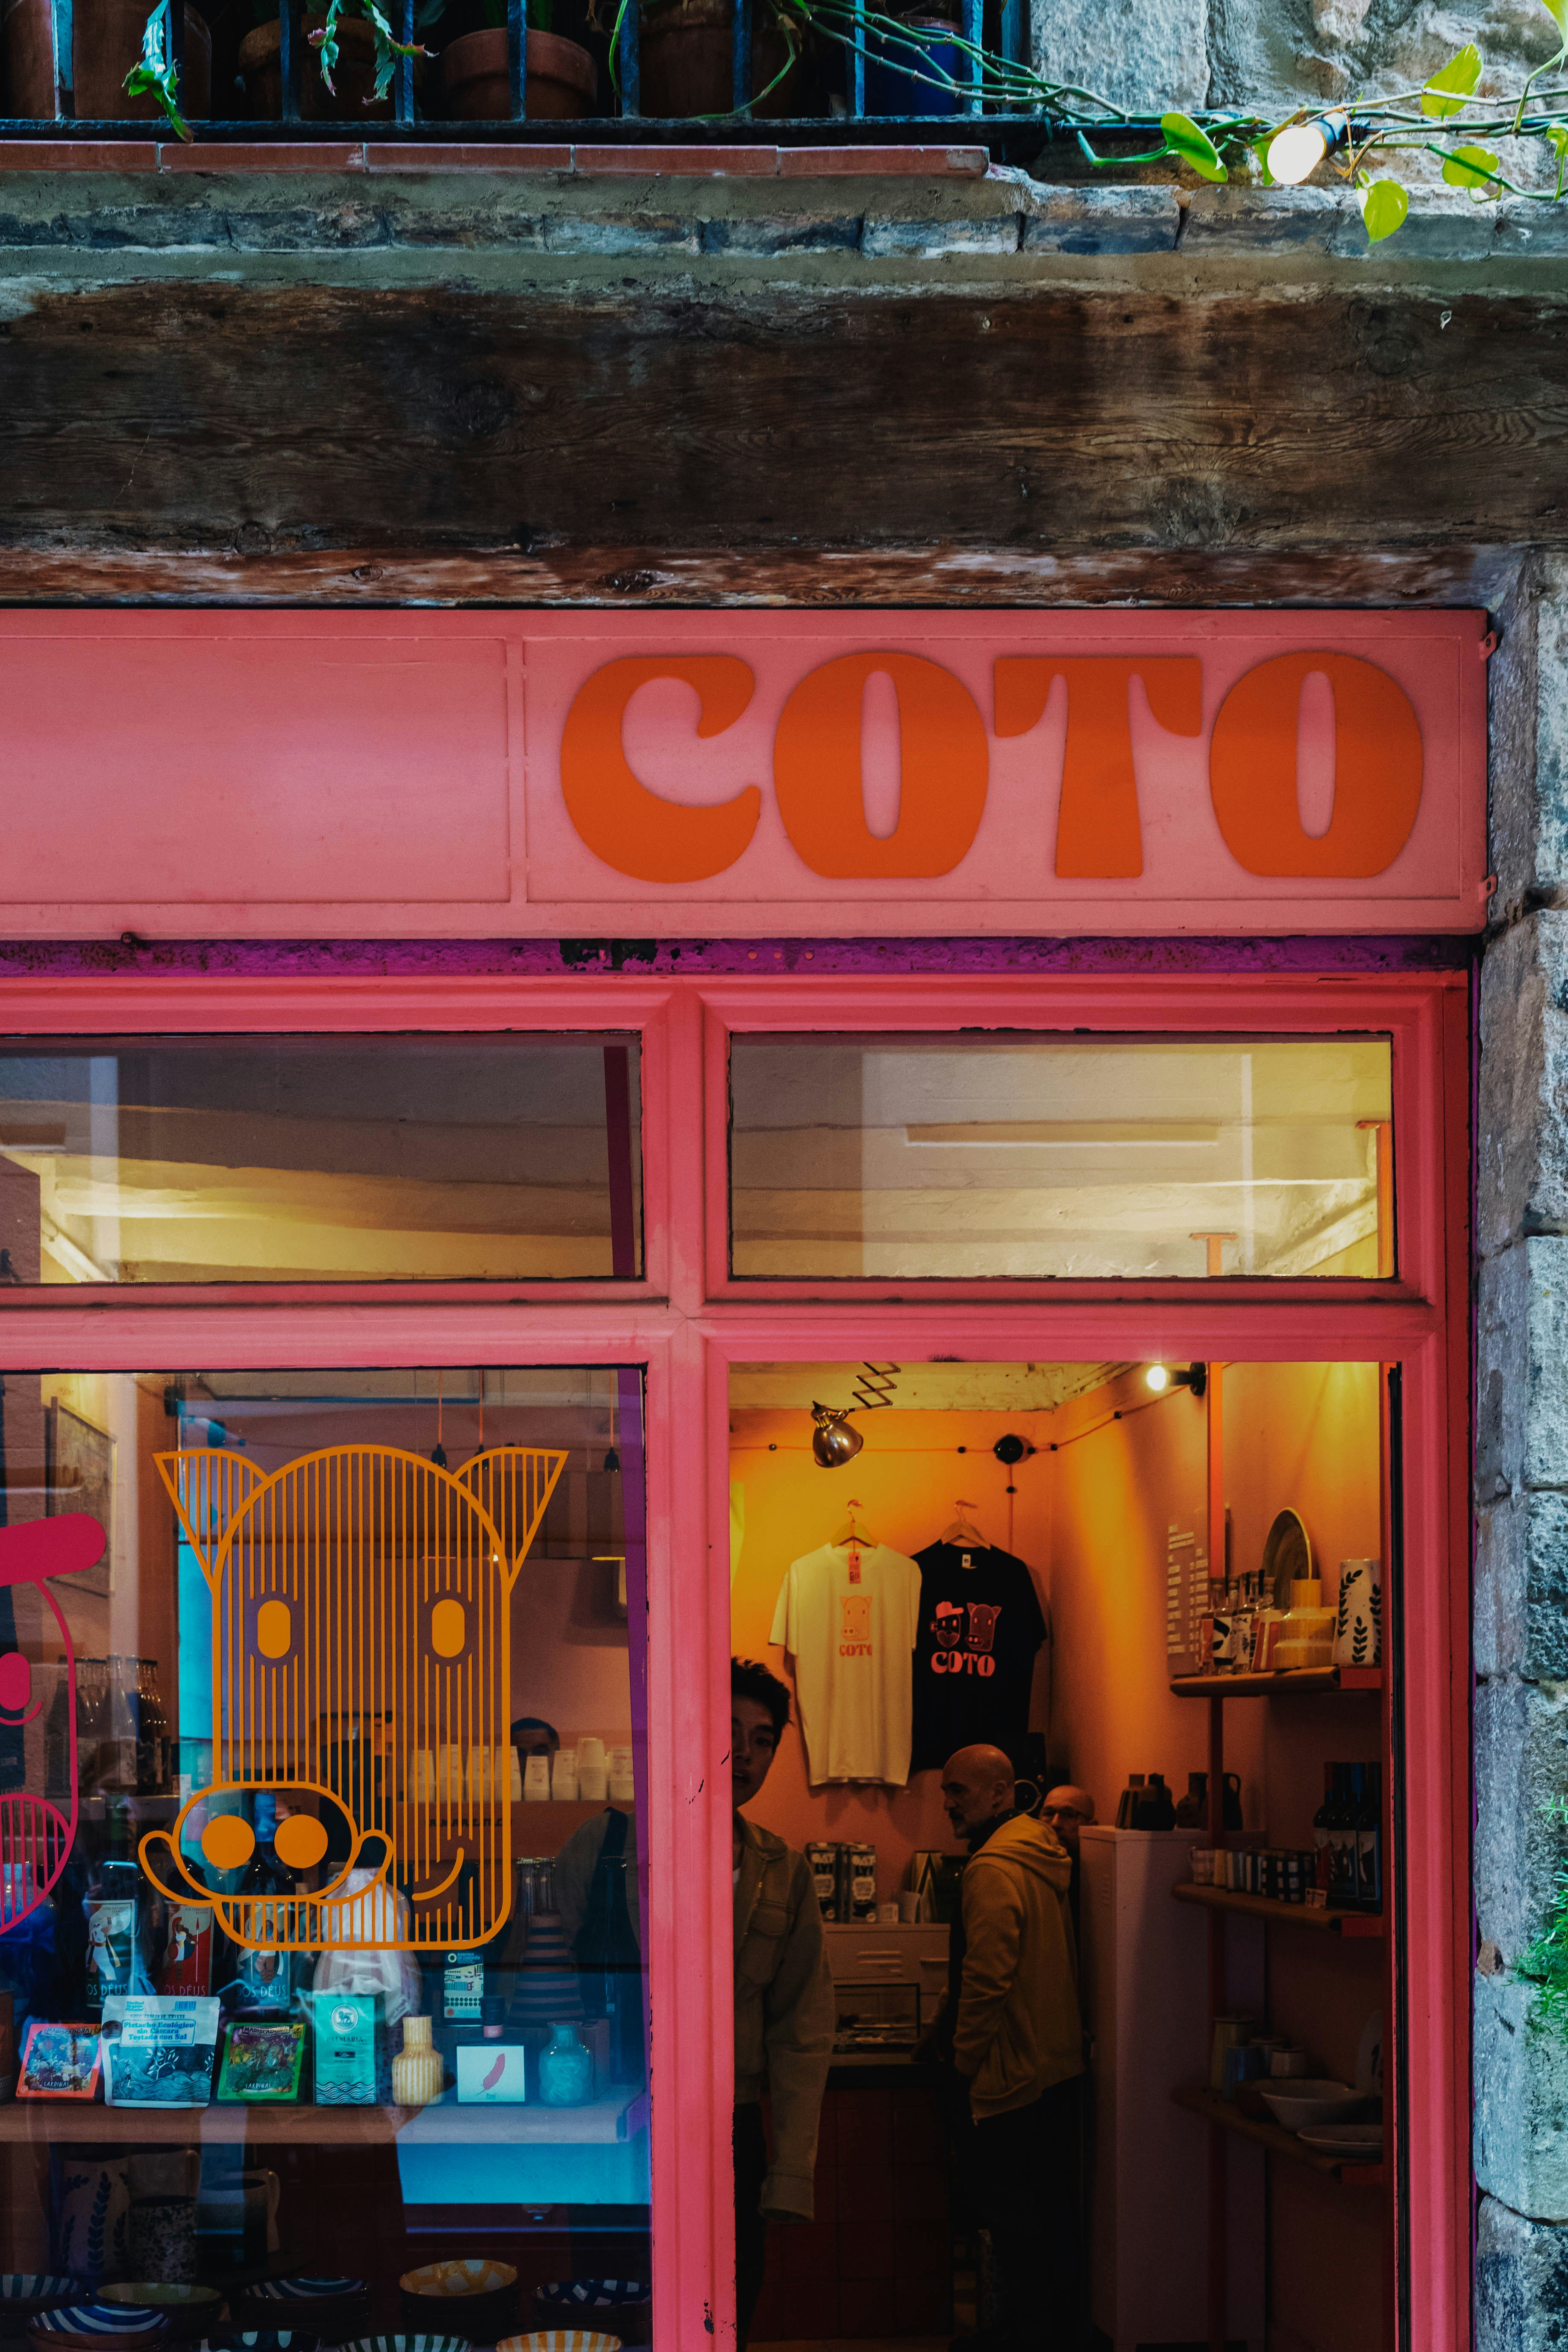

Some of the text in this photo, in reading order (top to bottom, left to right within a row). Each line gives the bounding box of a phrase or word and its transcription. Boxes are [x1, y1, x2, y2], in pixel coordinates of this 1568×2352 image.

[560, 651, 1424, 884] COTO
[931, 1650, 995, 1677] COTO
[261, 1984, 286, 1997] DÉUS
